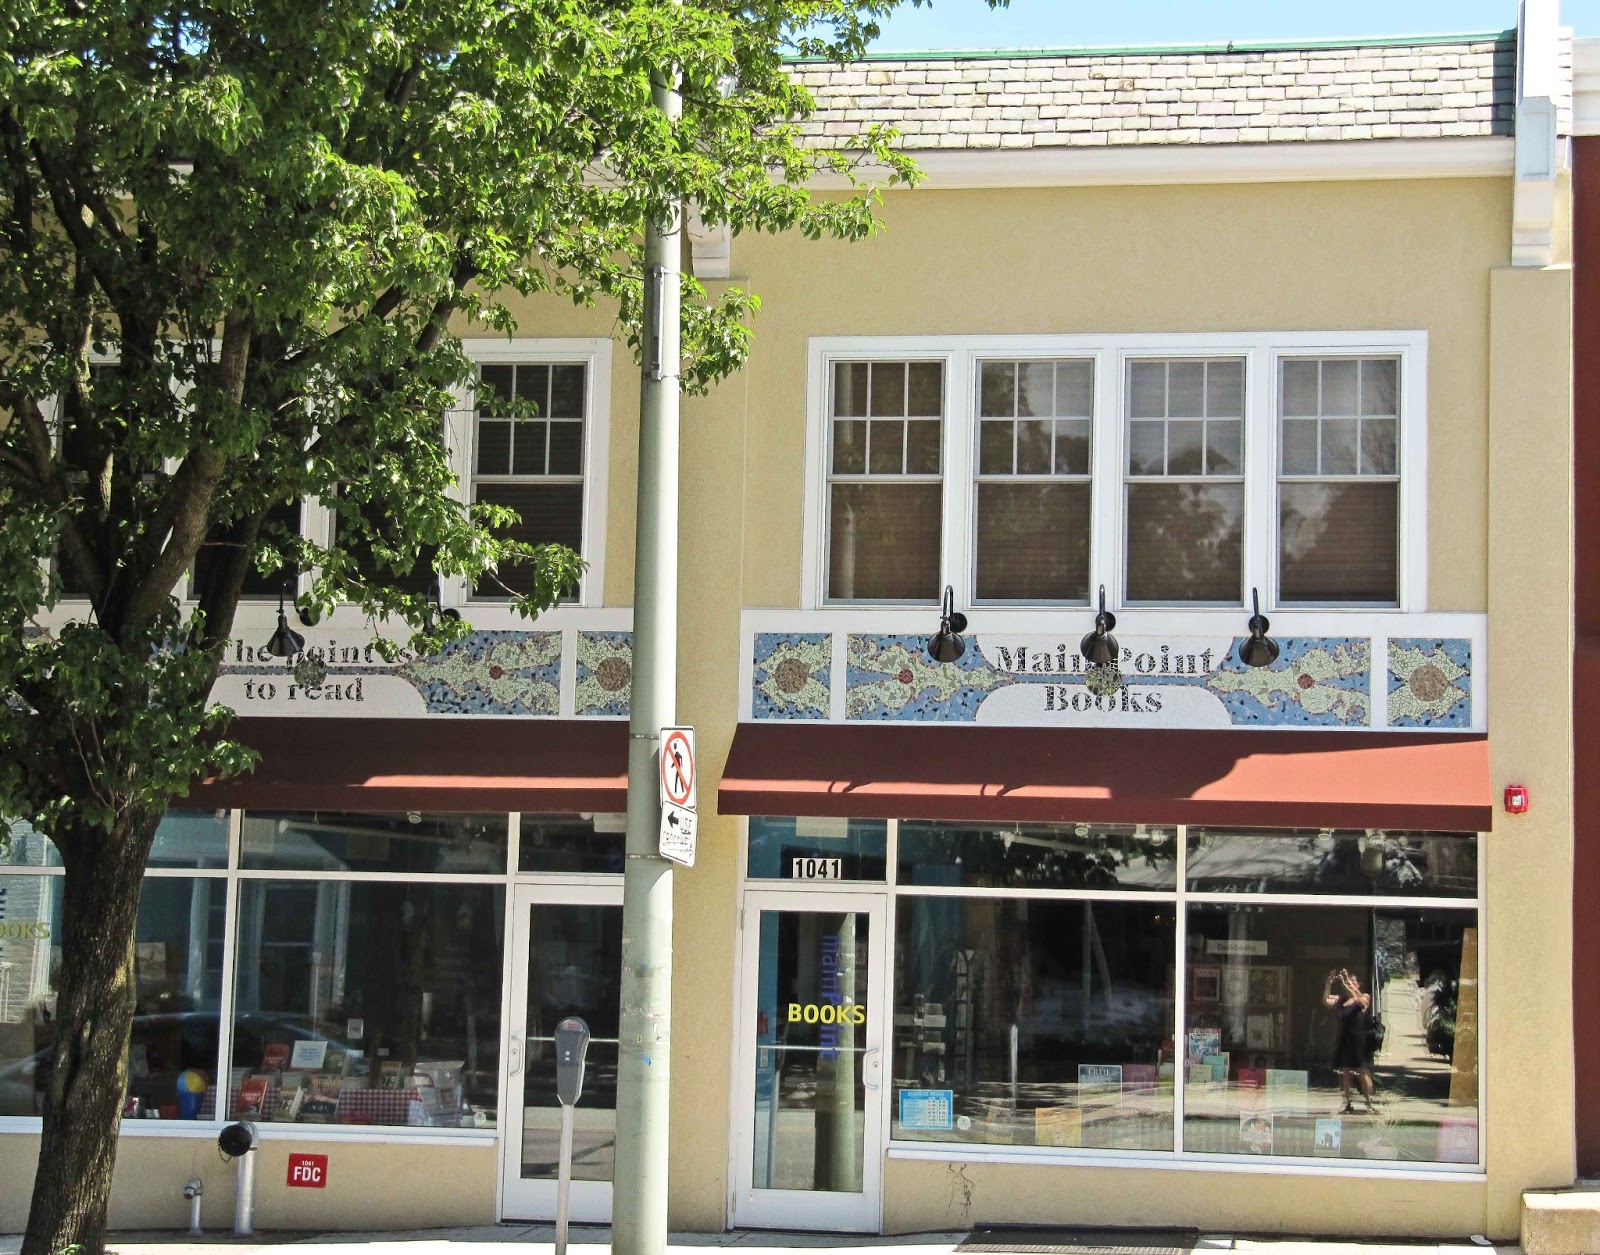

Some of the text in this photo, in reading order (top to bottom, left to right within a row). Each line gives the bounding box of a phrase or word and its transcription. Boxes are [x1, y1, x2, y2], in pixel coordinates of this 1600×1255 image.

[221, 639, 274, 662] he
[244, 677, 365, 701] to read
[1043, 683, 1163, 712] Books
[795, 858, 841, 879] 1041
[0, 921, 51, 940] OOKS
[820, 935, 846, 1060] mainPint
[787, 1002, 866, 1025] BOOKS
[293, 1166, 321, 1182] FDC
